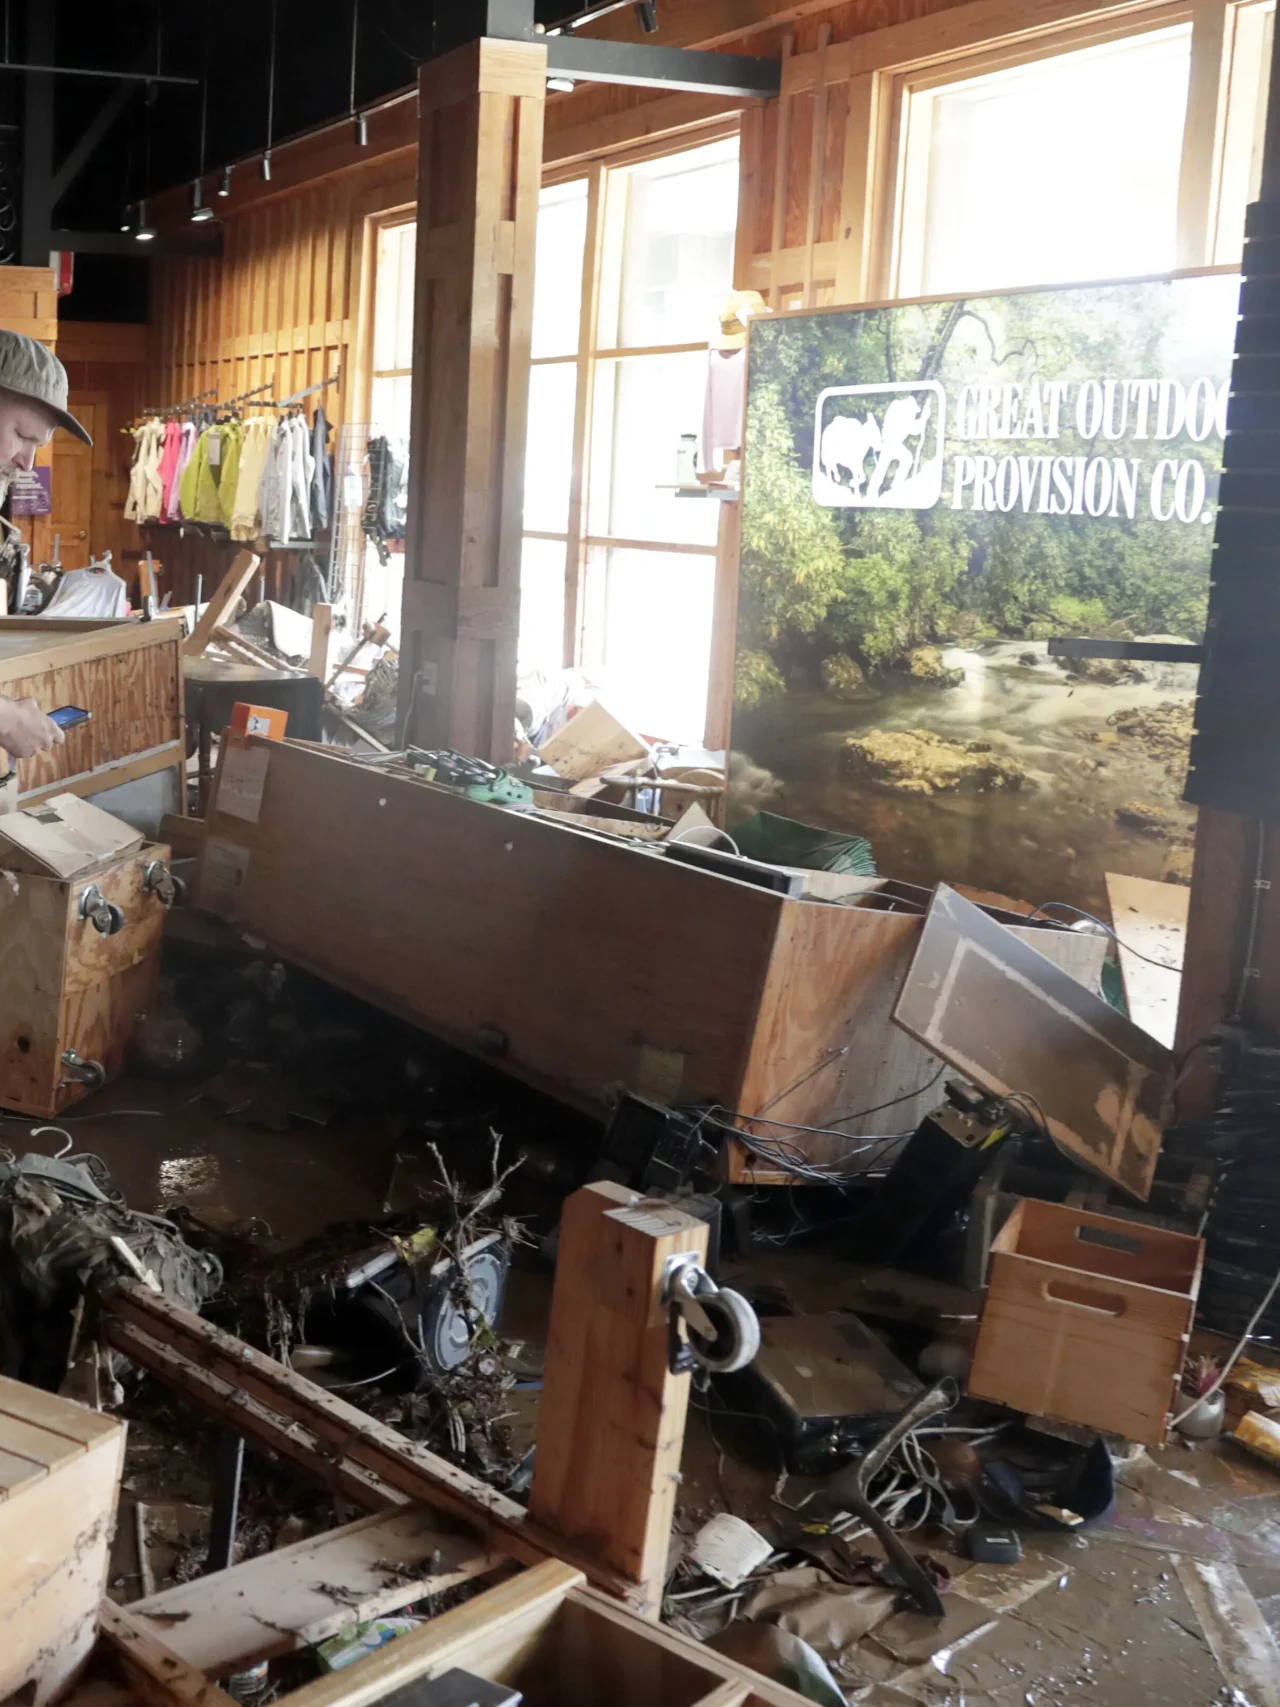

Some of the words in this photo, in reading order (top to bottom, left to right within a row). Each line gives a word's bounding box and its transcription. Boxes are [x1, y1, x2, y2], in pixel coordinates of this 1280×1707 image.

[956, 380, 1069, 439] GREAT
[950, 456, 1141, 519] PROVISION
[1150, 459, 1212, 525] CO.
